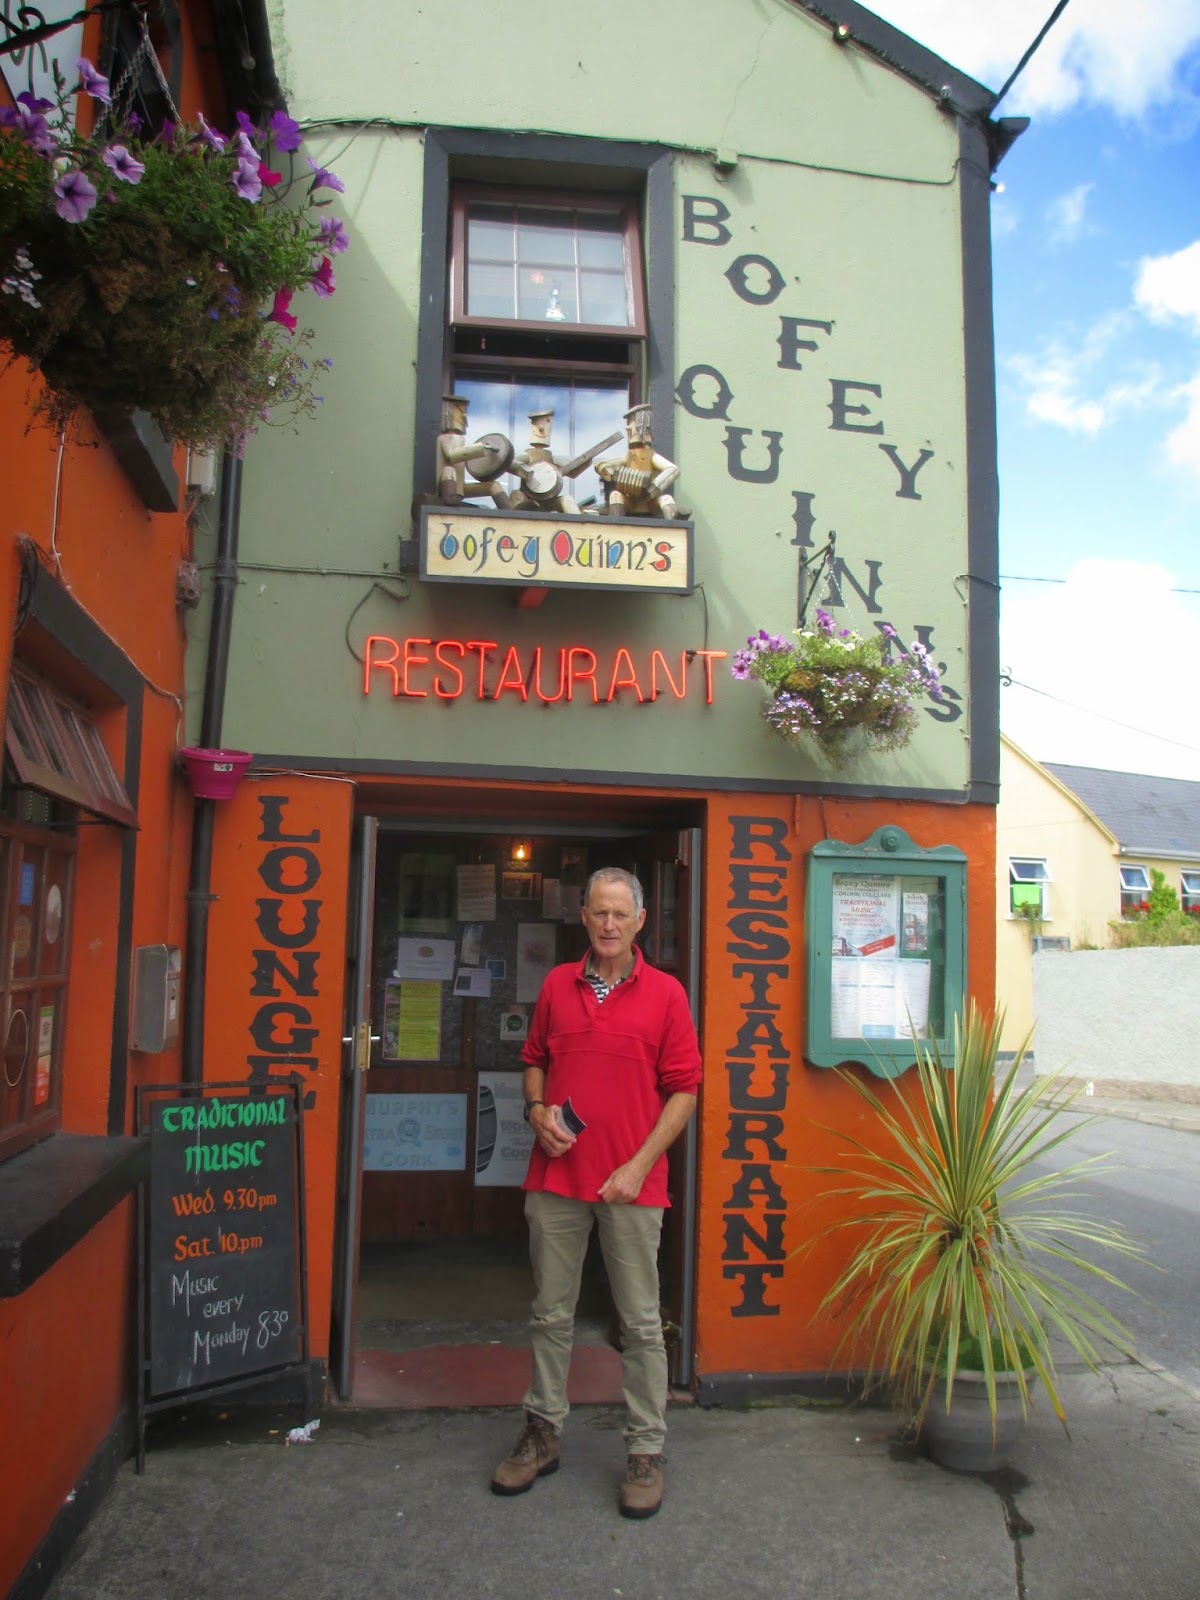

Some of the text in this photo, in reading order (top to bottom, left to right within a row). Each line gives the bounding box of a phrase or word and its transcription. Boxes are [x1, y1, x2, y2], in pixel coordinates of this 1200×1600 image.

[682, 195, 935, 500] BOFEY
[364, 635, 727, 704] RESTAURANT
[722, 815, 792, 1318] RESTAURANT
[184, 1140, 266, 1172] MUSIC
[172, 1187, 216, 1216] Wed.
[175, 1235, 215, 1261] Sat.
[173, 1269, 219, 1317] Music
[203, 1293, 244, 1318] every
[194, 1321, 250, 1366] Monday
